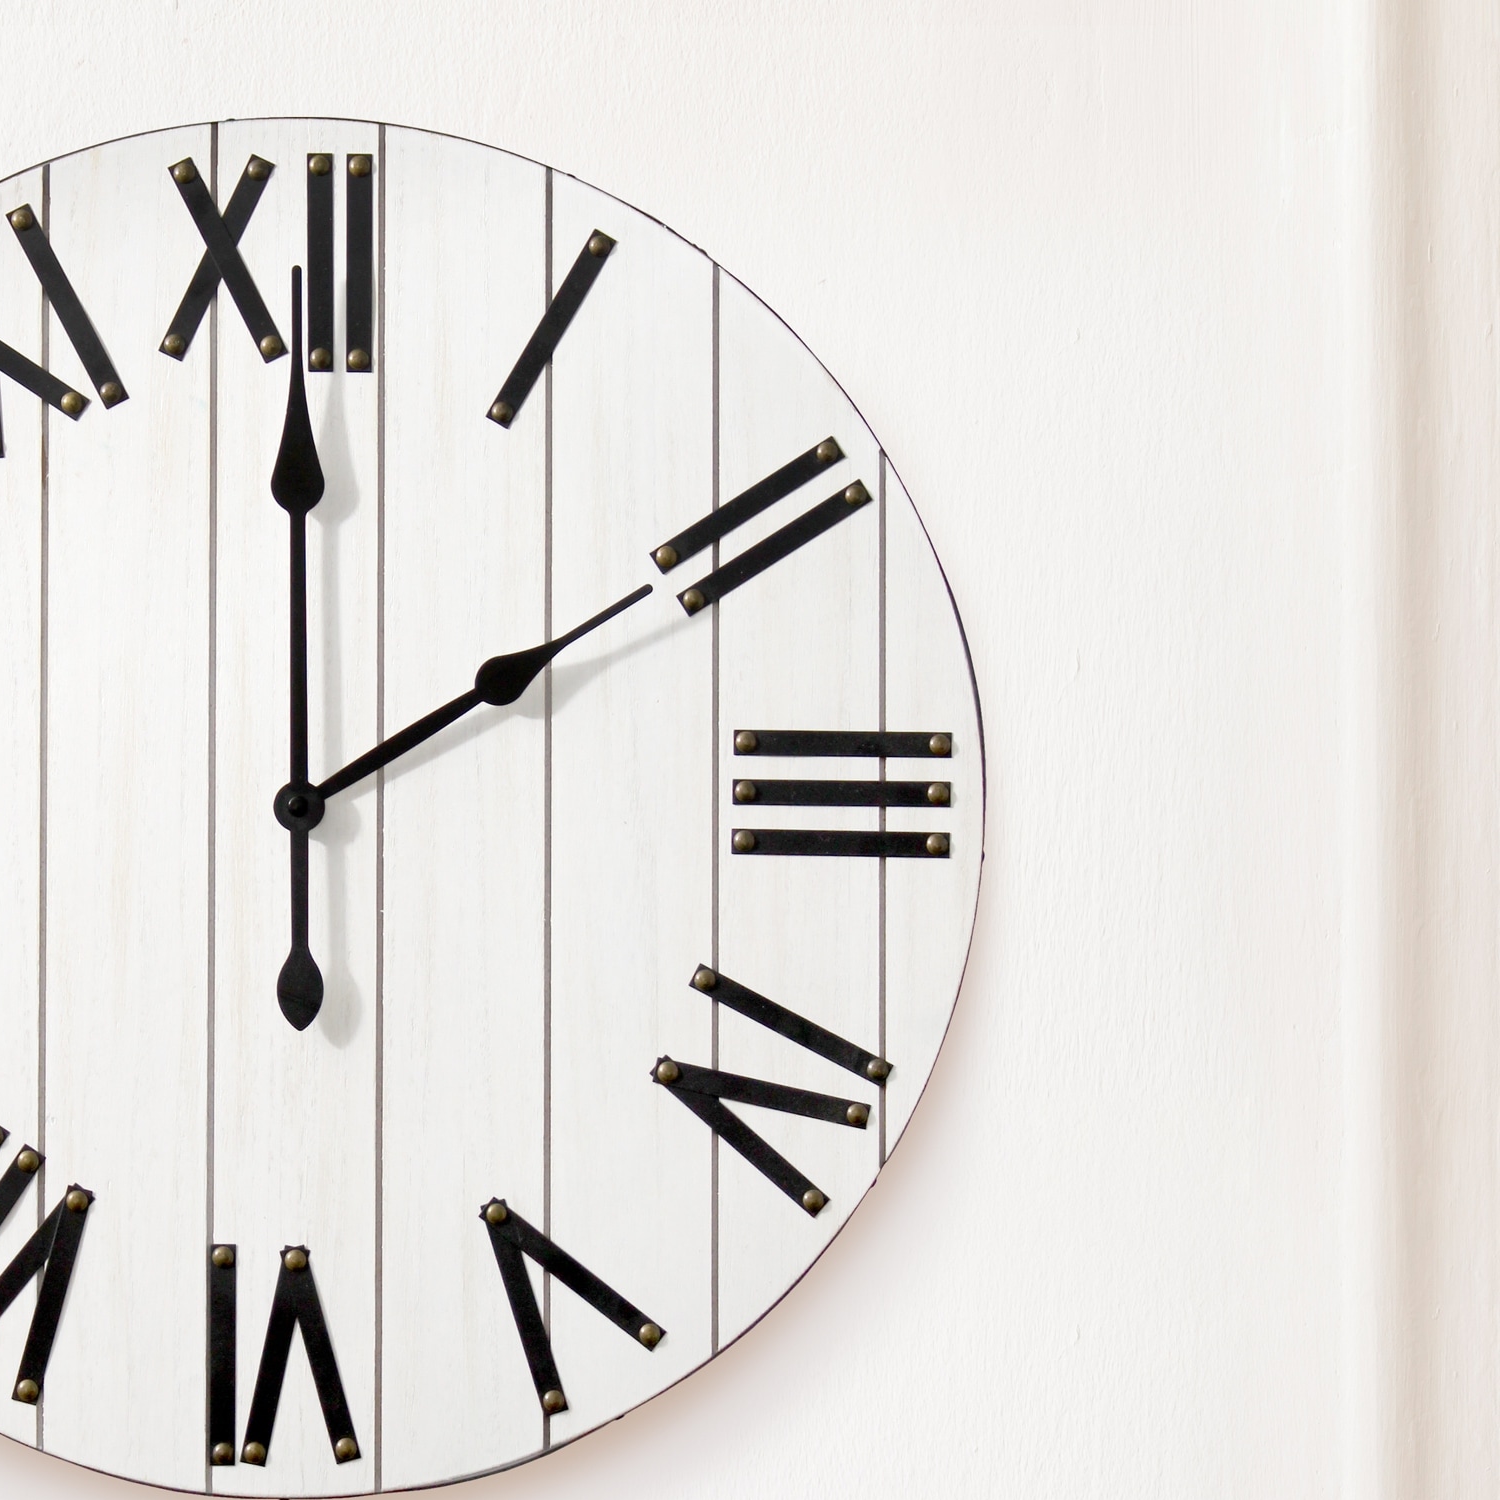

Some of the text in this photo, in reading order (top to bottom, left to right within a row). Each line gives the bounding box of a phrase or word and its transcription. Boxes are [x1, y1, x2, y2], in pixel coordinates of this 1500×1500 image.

[158, 153, 372, 372] XII
[486, 229, 616, 429] I
[650, 436, 873, 617] II
[731, 729, 953, 858] III
[650, 963, 894, 1218] IV
[209, 1244, 361, 1467] VI
[479, 1197, 666, 1415] V
